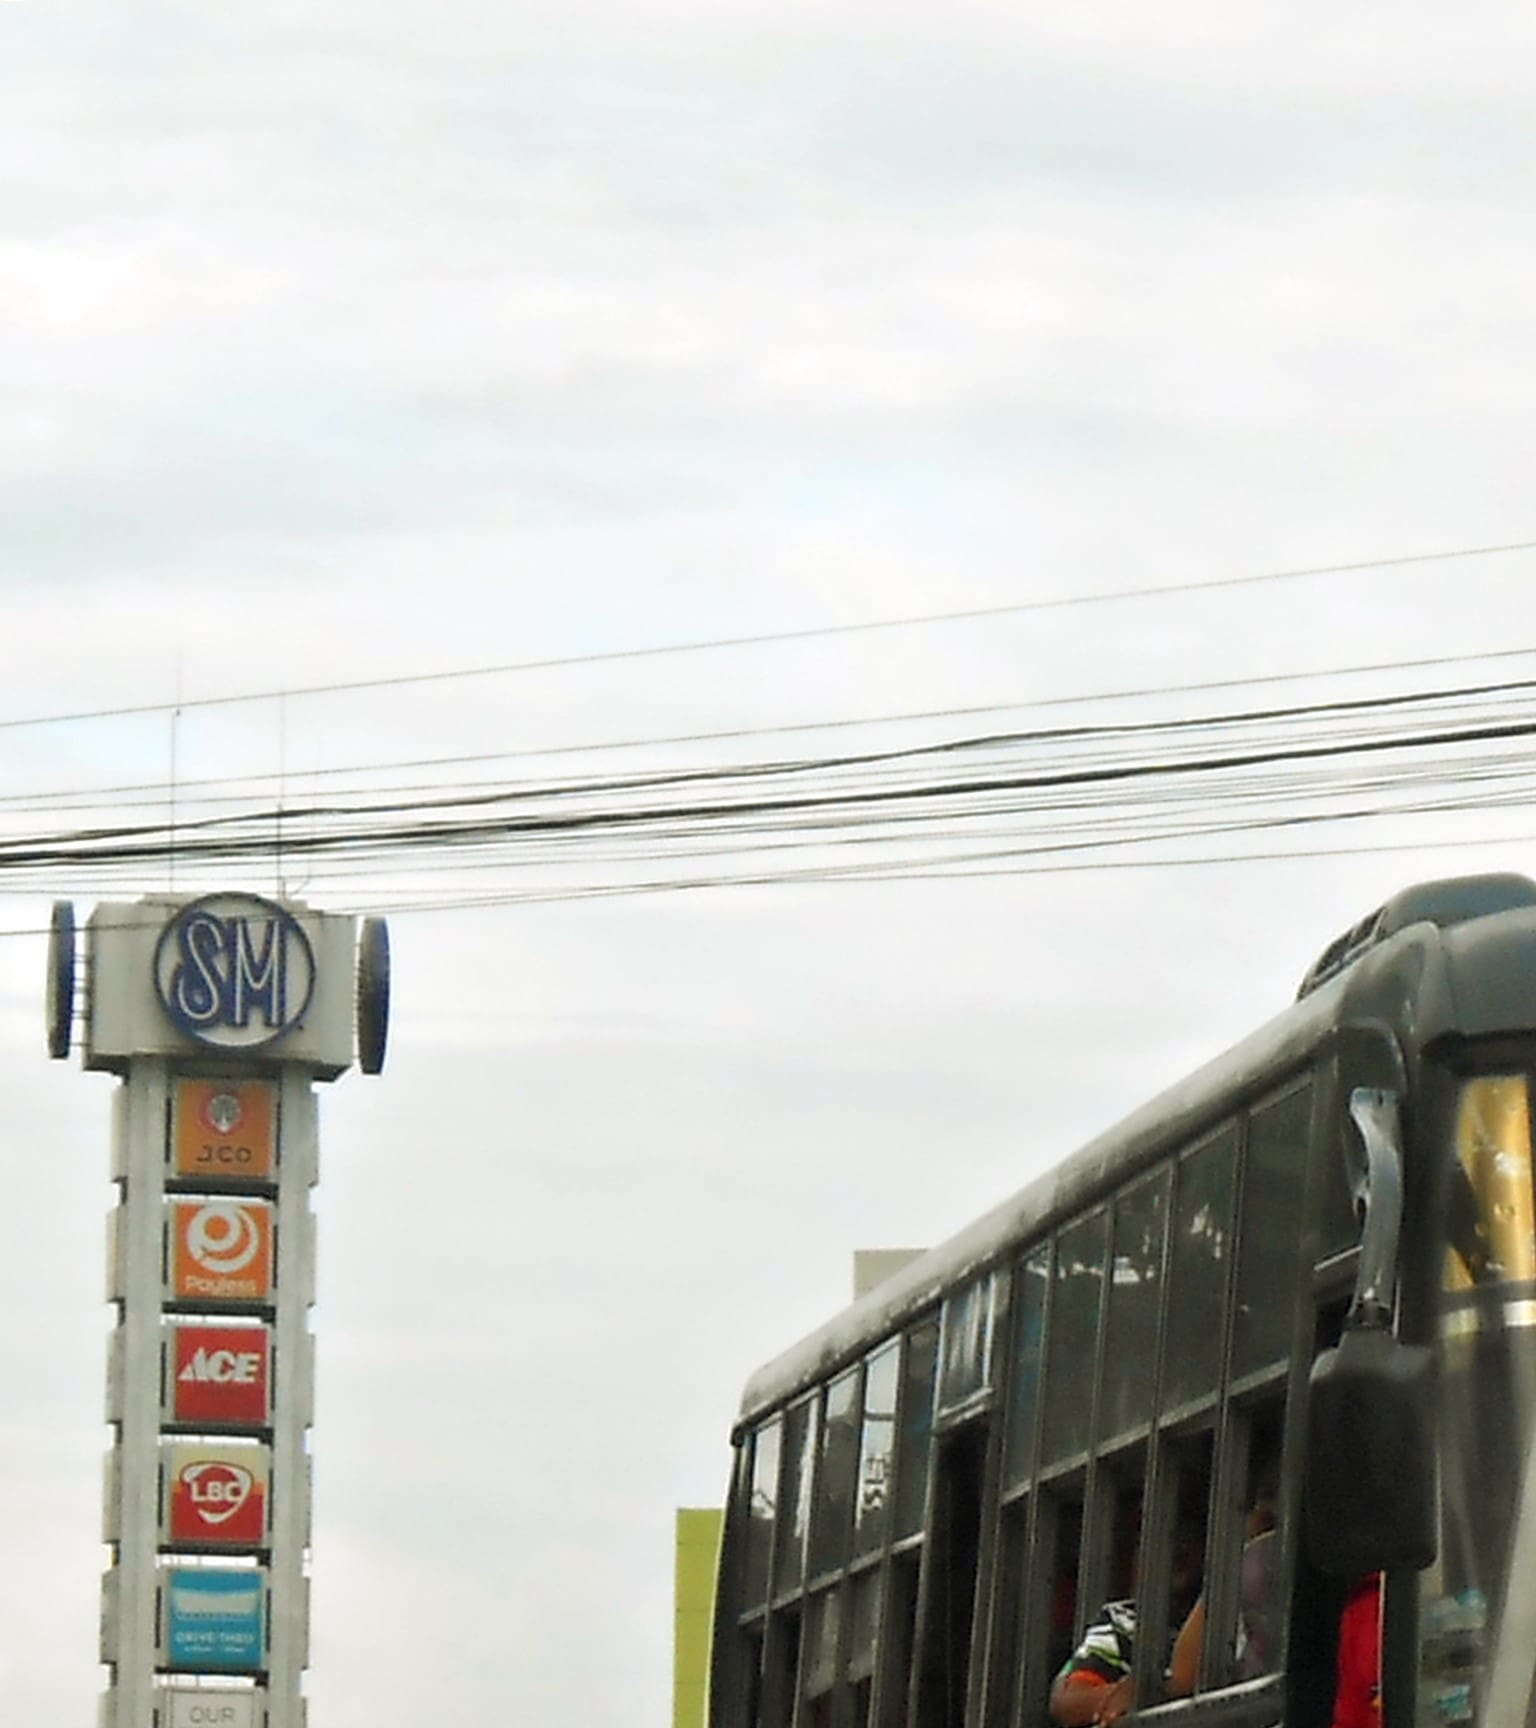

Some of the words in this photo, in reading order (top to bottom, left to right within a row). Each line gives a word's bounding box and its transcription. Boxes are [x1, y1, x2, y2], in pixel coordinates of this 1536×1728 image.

[175, 911, 287, 1028] SM
[178, 1347, 260, 1383] ACE
[191, 1481, 241, 1502] LBC
[189, 1706, 236, 1725] OUR
